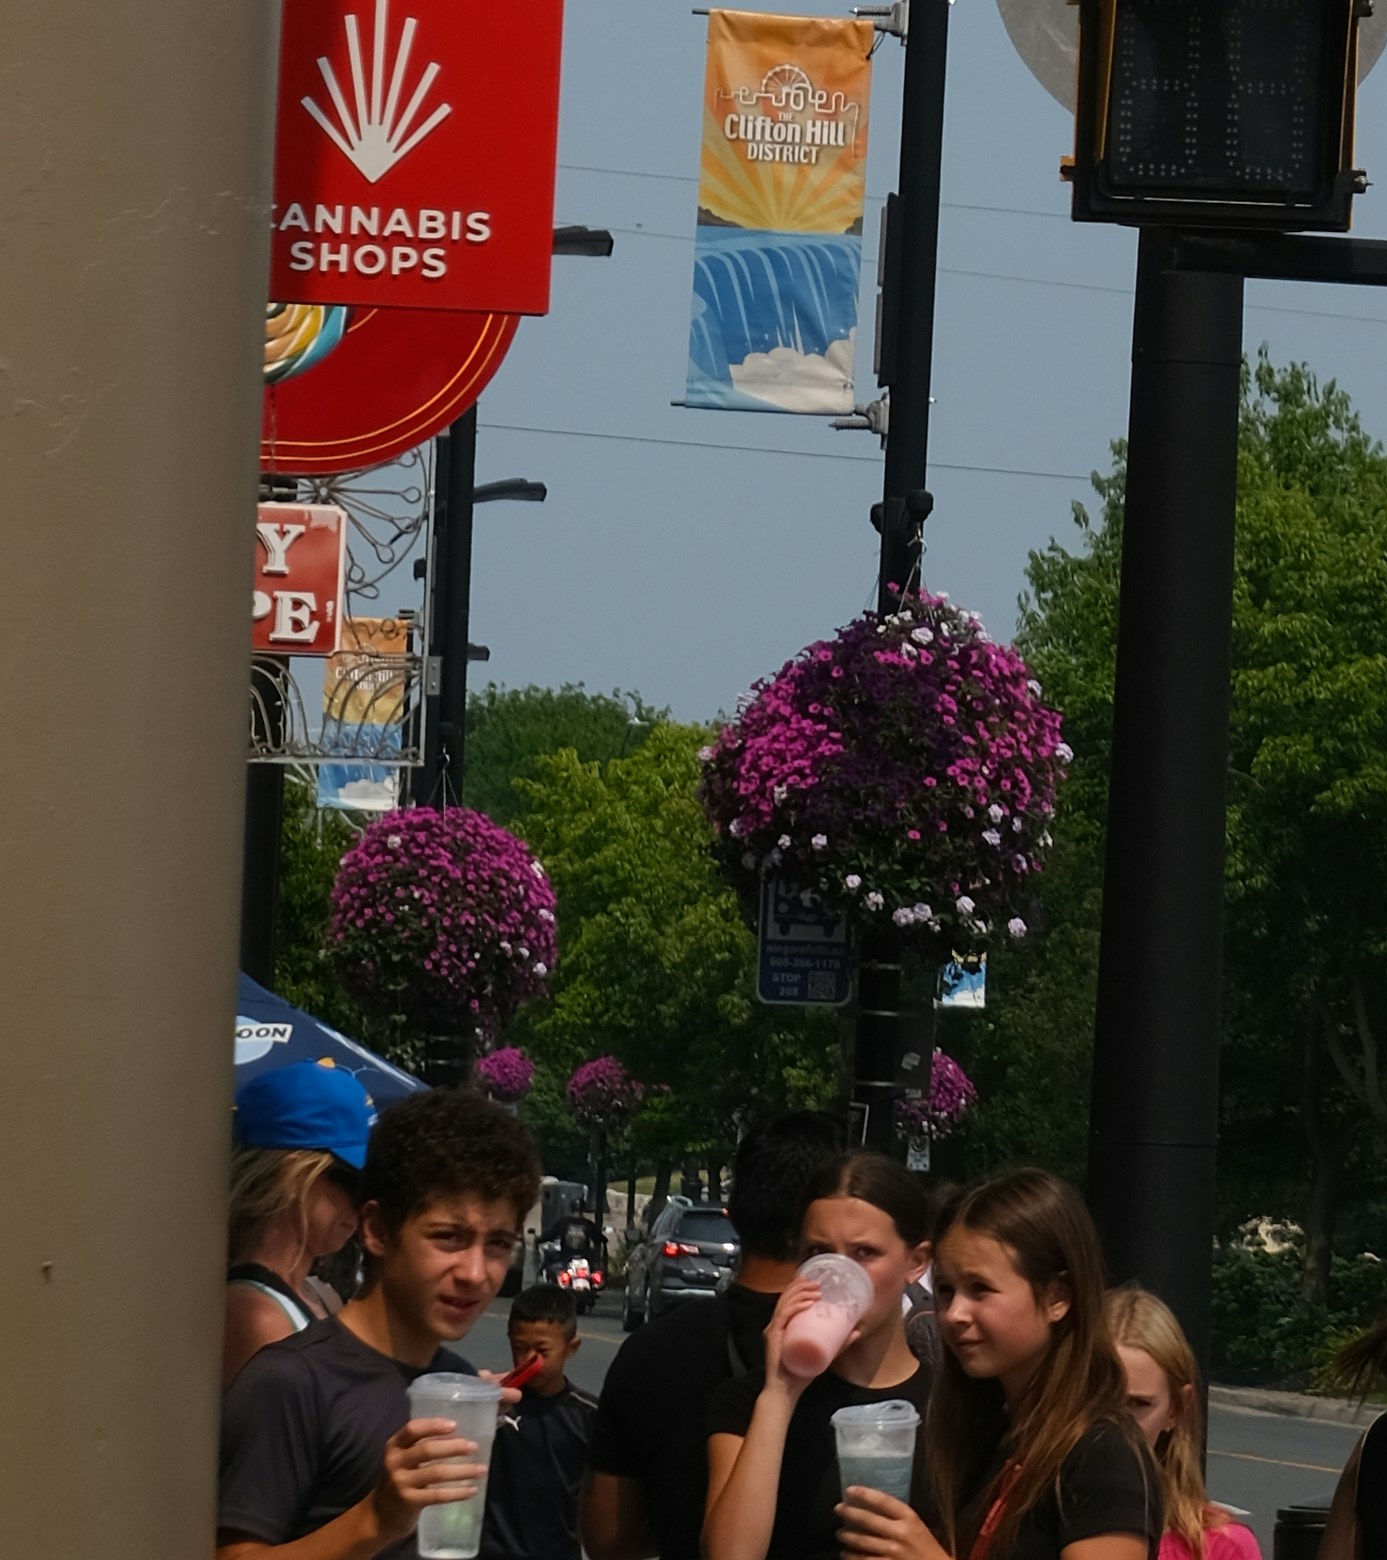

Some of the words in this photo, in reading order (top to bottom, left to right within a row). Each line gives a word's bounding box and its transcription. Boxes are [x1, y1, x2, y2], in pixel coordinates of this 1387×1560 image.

[778, 111, 794, 121] THE
[724, 113, 801, 143] Clifton
[806, 119, 846, 146] Hill
[747, 143, 819, 164] DISTRICT
[289, 241, 448, 278] SHOPS
[772, 972, 801, 983] STOP
